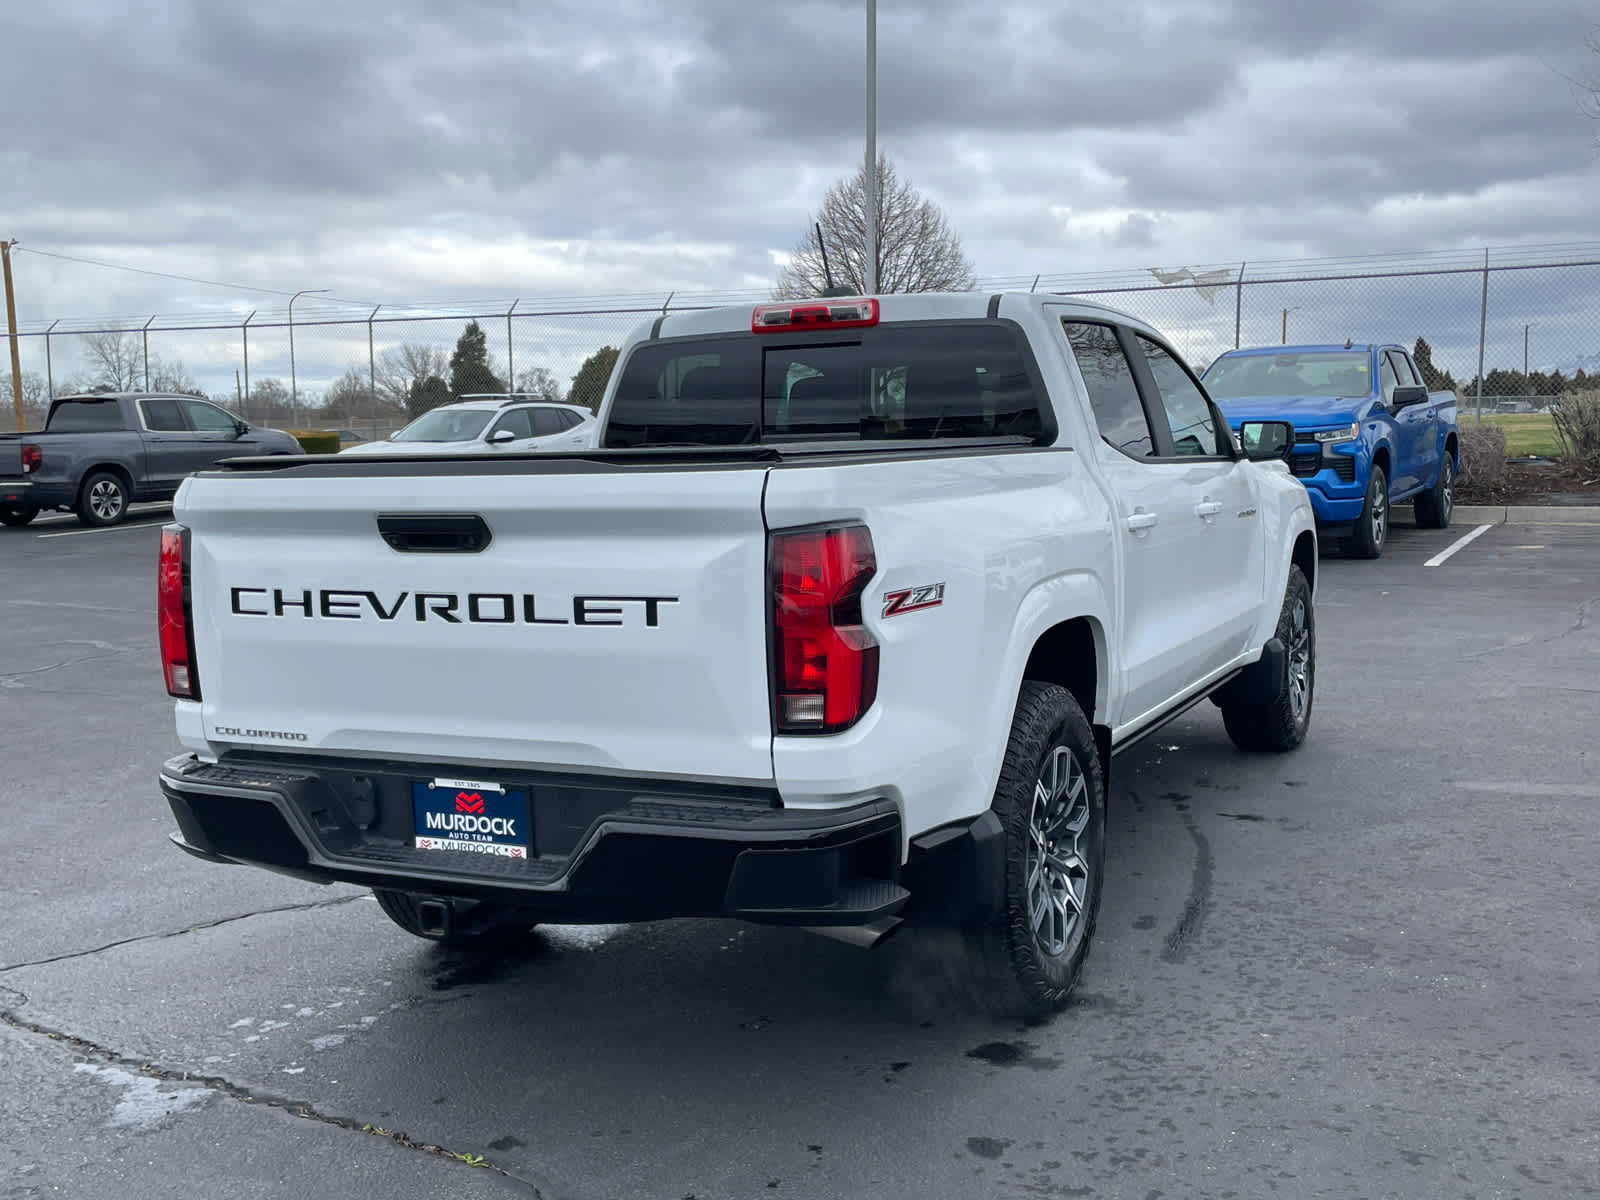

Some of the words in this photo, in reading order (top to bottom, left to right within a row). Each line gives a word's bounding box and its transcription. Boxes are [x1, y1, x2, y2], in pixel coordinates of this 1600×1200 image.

[231, 586, 680, 627] CHEVROLET
[881, 582, 945, 620] Z71
[215, 726, 307, 741] COLORADO
[426, 811, 516, 836] MURDOCK
[448, 831, 469, 840] AUTO
[472, 834, 493, 842] TEAM
[441, 840, 501, 856] MURDOCK
